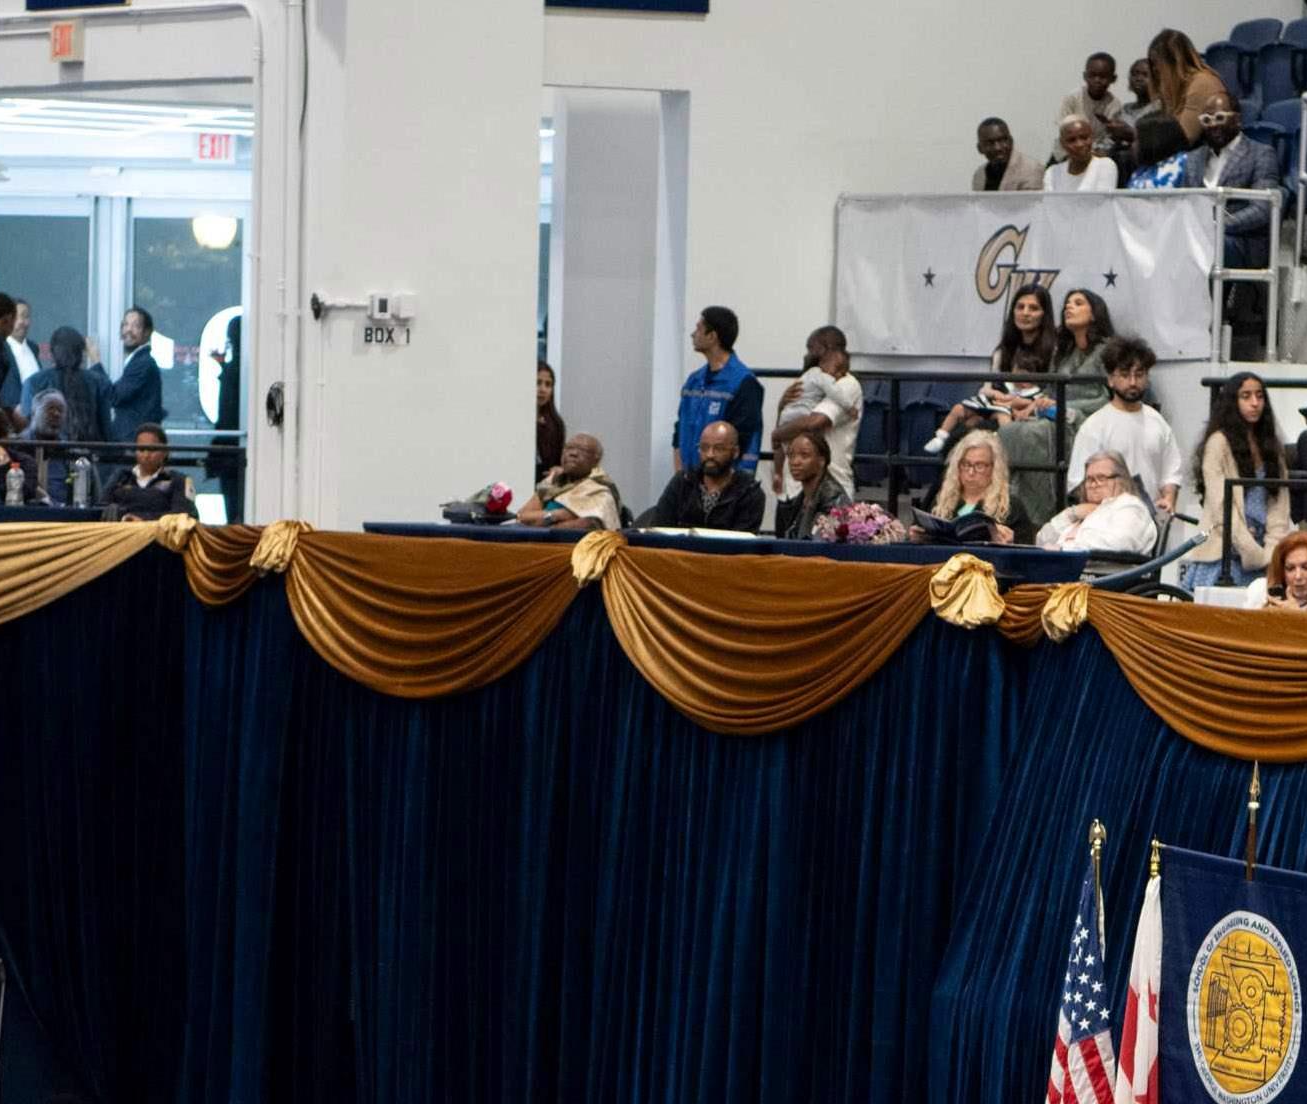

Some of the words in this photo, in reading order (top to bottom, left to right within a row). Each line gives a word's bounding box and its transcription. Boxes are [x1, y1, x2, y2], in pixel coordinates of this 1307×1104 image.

[199, 133, 229, 160] EXIT
[364, 327, 395, 343] BOX
[406, 327, 410, 344] 1
[1193, 952, 1208, 993] SCHOOL
[1251, 920, 1270, 936] AND
[1270, 932, 1292, 969] APPLIED
